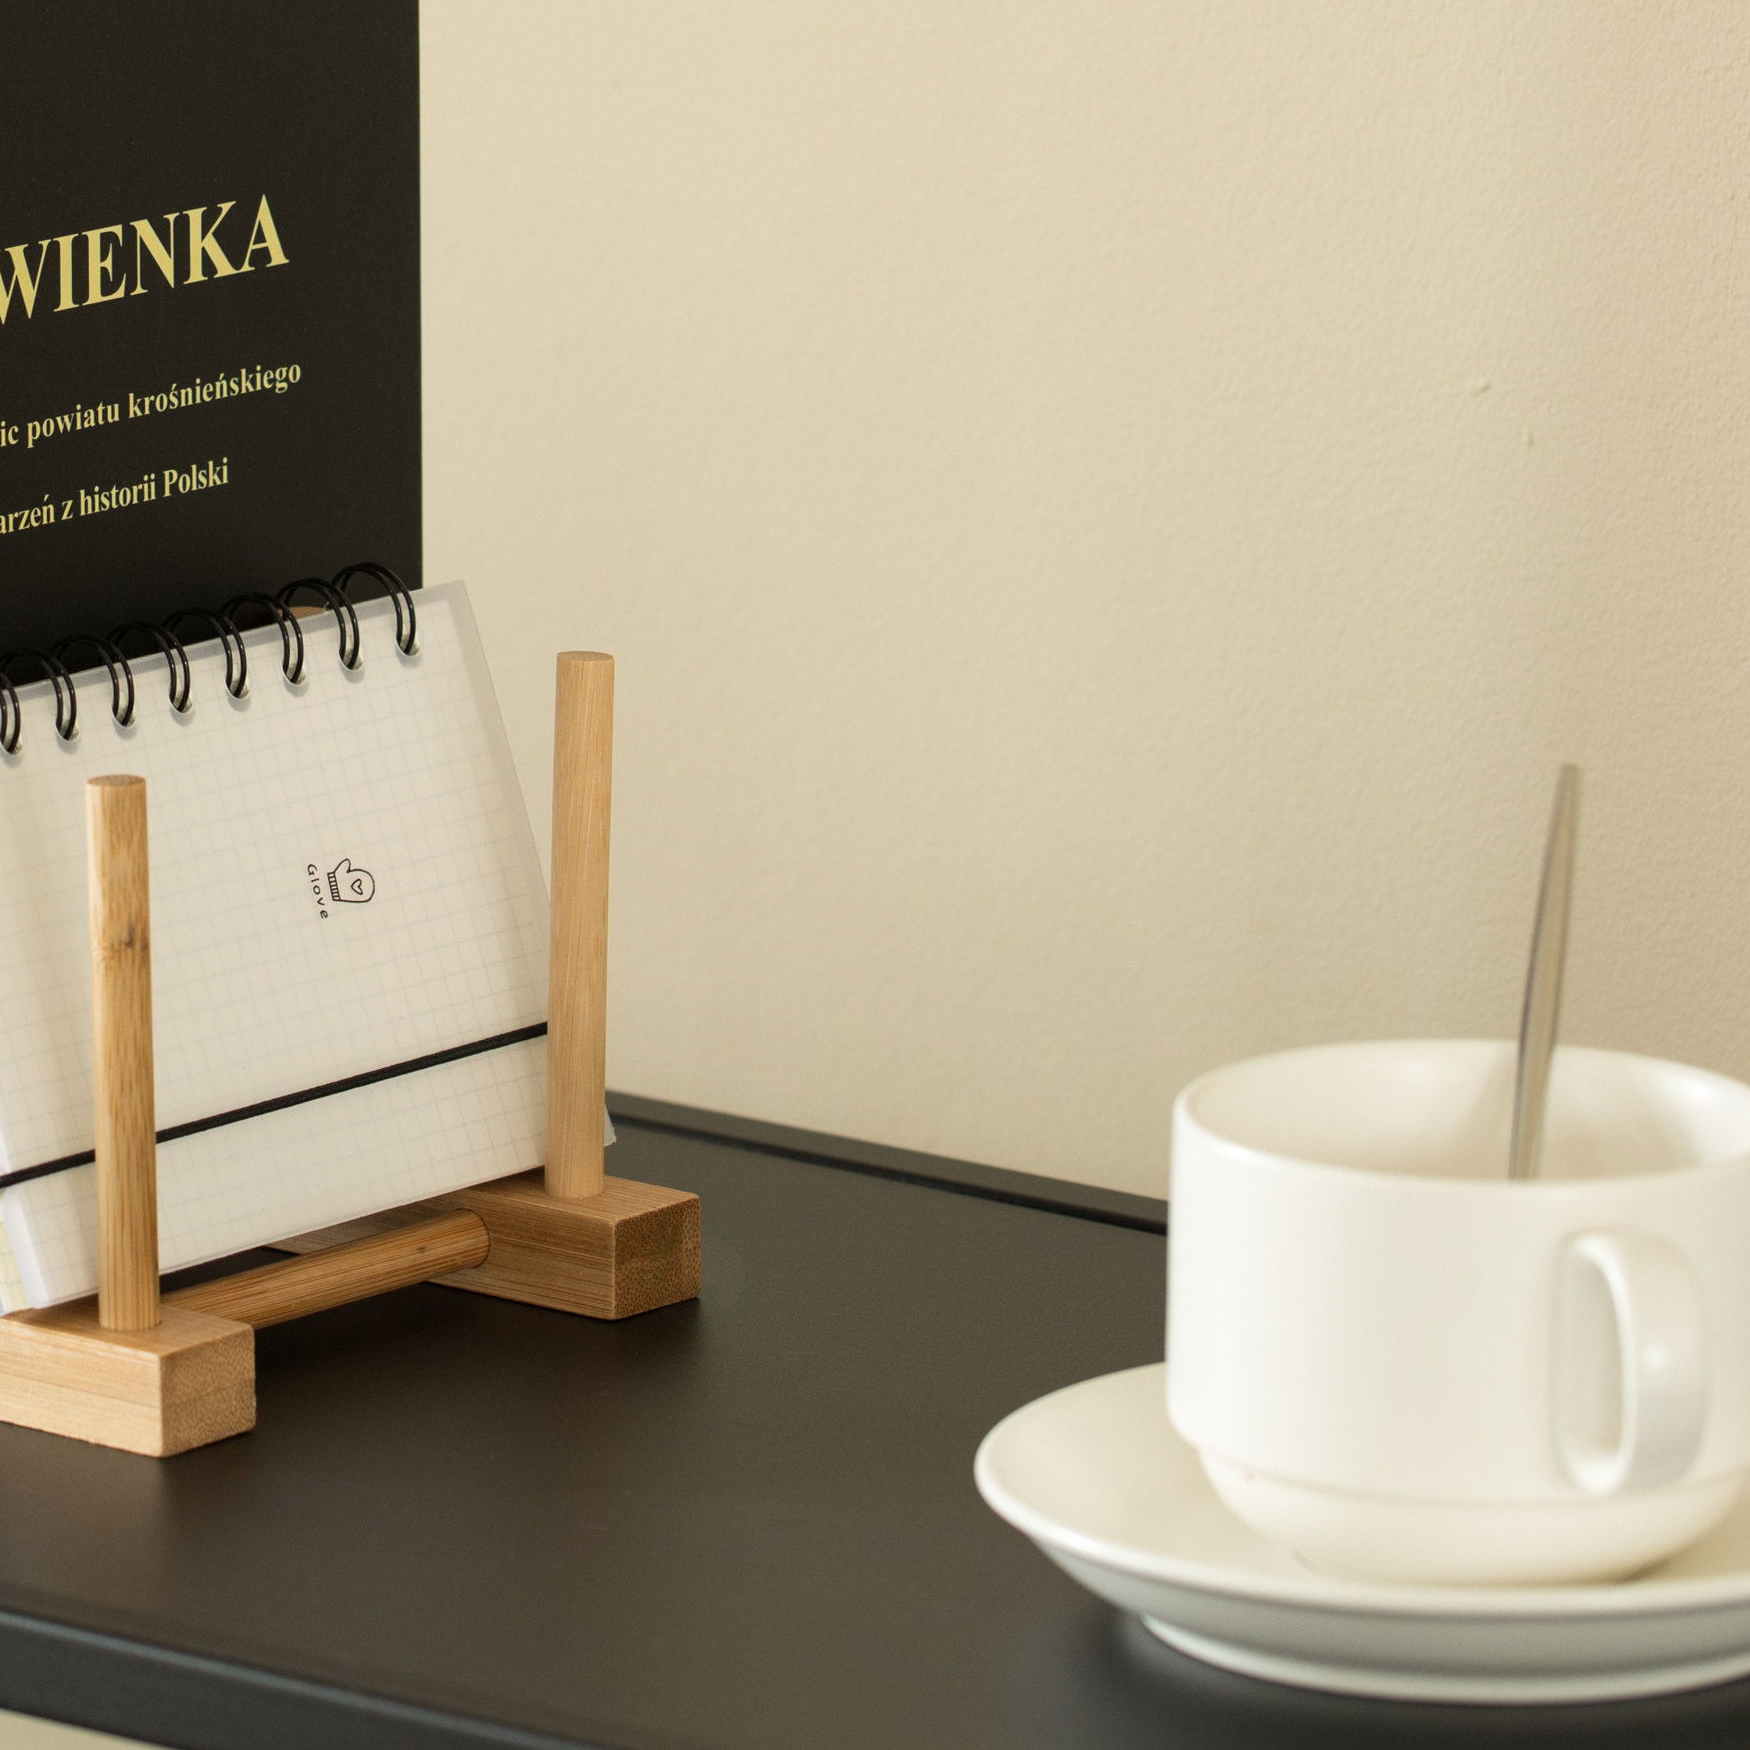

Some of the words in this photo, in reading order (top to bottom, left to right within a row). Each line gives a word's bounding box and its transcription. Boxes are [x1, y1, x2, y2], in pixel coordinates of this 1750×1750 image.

[26, 403, 121, 449] powiatu
[128, 364, 302, 420] krośnieńskiego
[61, 499, 74, 522] z
[79, 473, 158, 518] historii
[162, 455, 230, 499] Polski
[306, 863, 330, 920] Glove
